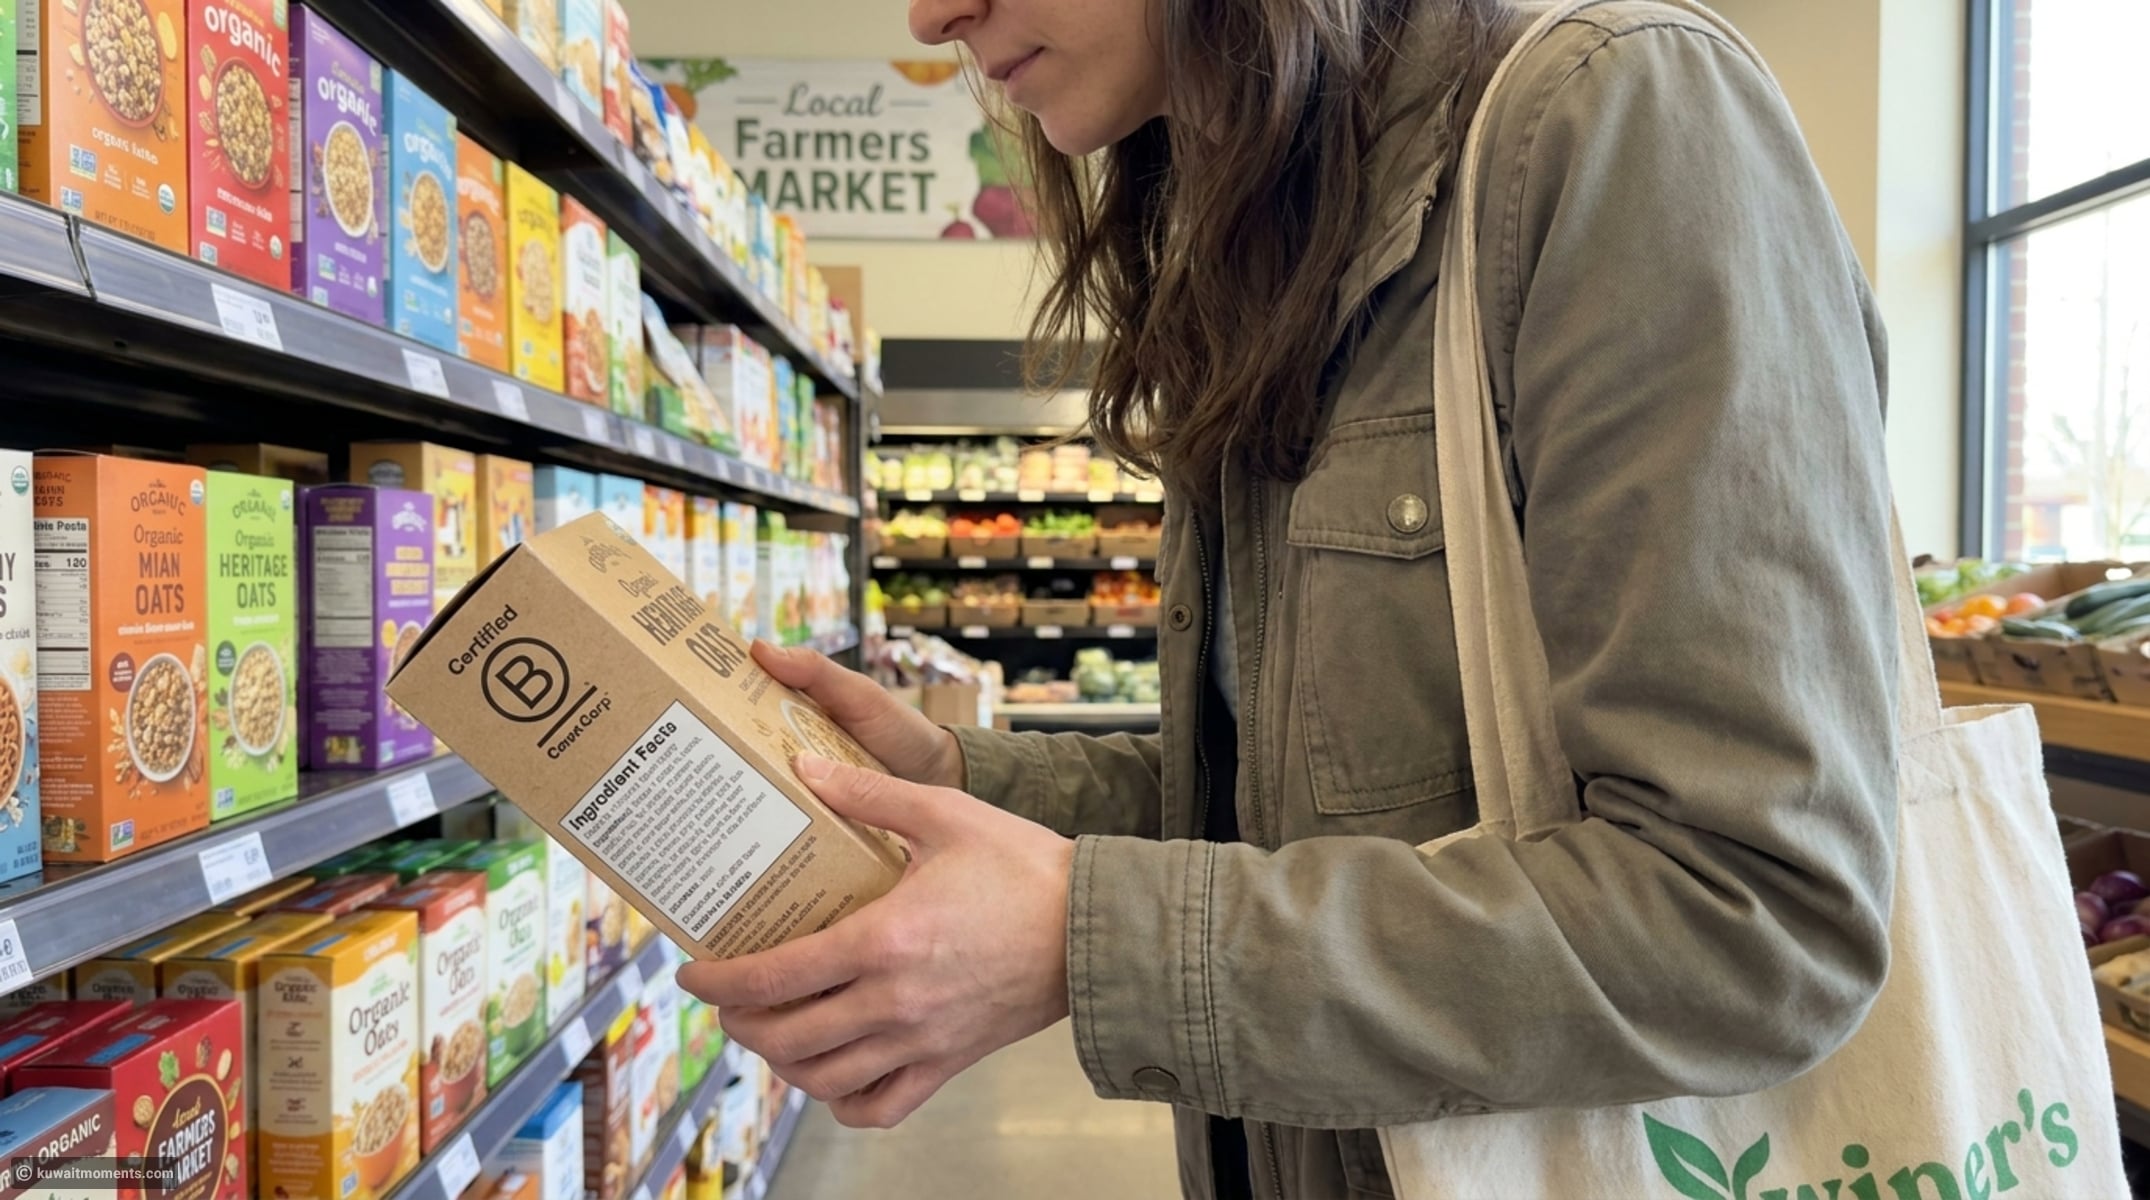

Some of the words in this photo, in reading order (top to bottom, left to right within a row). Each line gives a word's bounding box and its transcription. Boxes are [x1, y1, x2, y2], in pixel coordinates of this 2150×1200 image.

[204, 5, 281, 77] organic
[782, 83, 883, 117] Local
[735, 118, 931, 162] Farmers
[134, 524, 184, 548] Organic
[67, 558, 87, 568] 120
[139, 552, 180, 579] MIAN
[135, 584, 185, 616] OATS
[236, 581, 277, 609] OATS
[495, 655, 553, 710] B
[38, 1114, 101, 1165] ORGANIC
